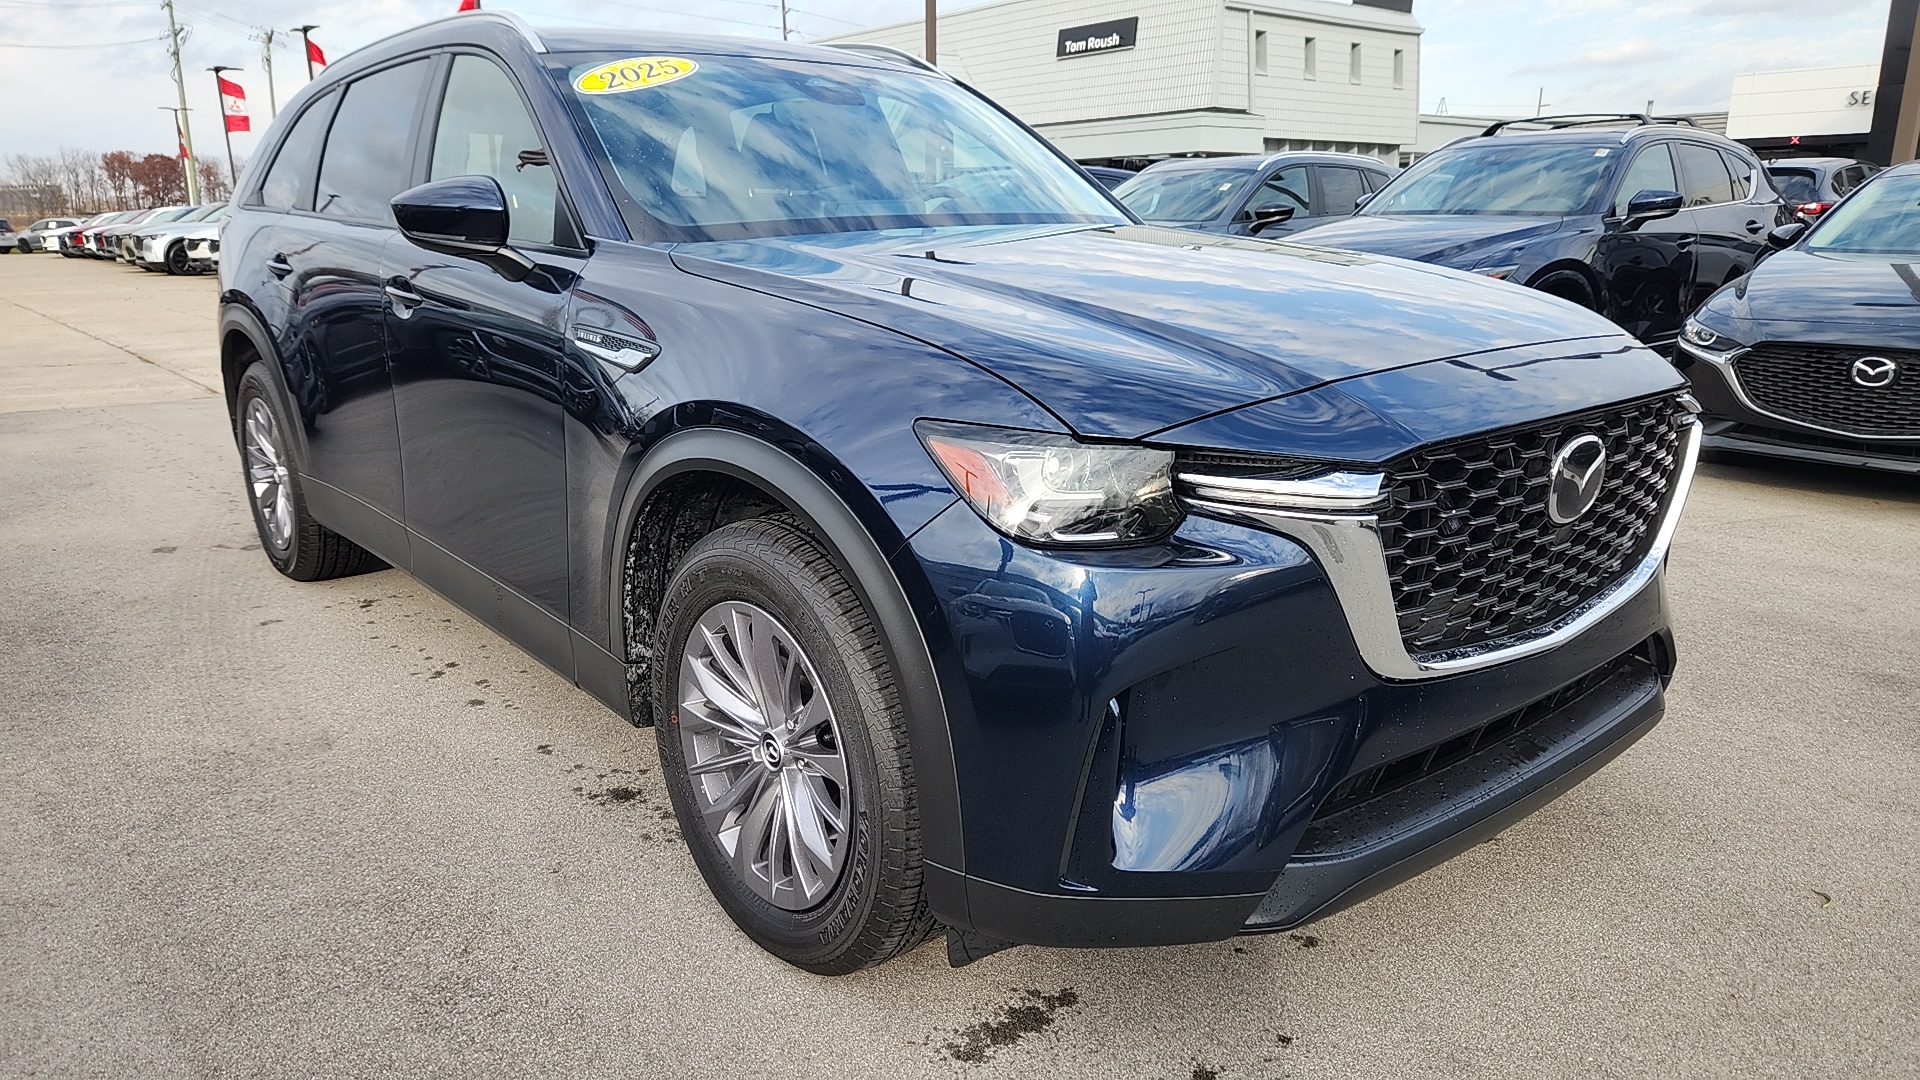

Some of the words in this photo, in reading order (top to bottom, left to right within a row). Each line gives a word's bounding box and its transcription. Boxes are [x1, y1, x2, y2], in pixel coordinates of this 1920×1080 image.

[1065, 40, 1086, 53] Tom
[1087, 32, 1120, 50] Roush
[599, 60, 680, 89] 2025
